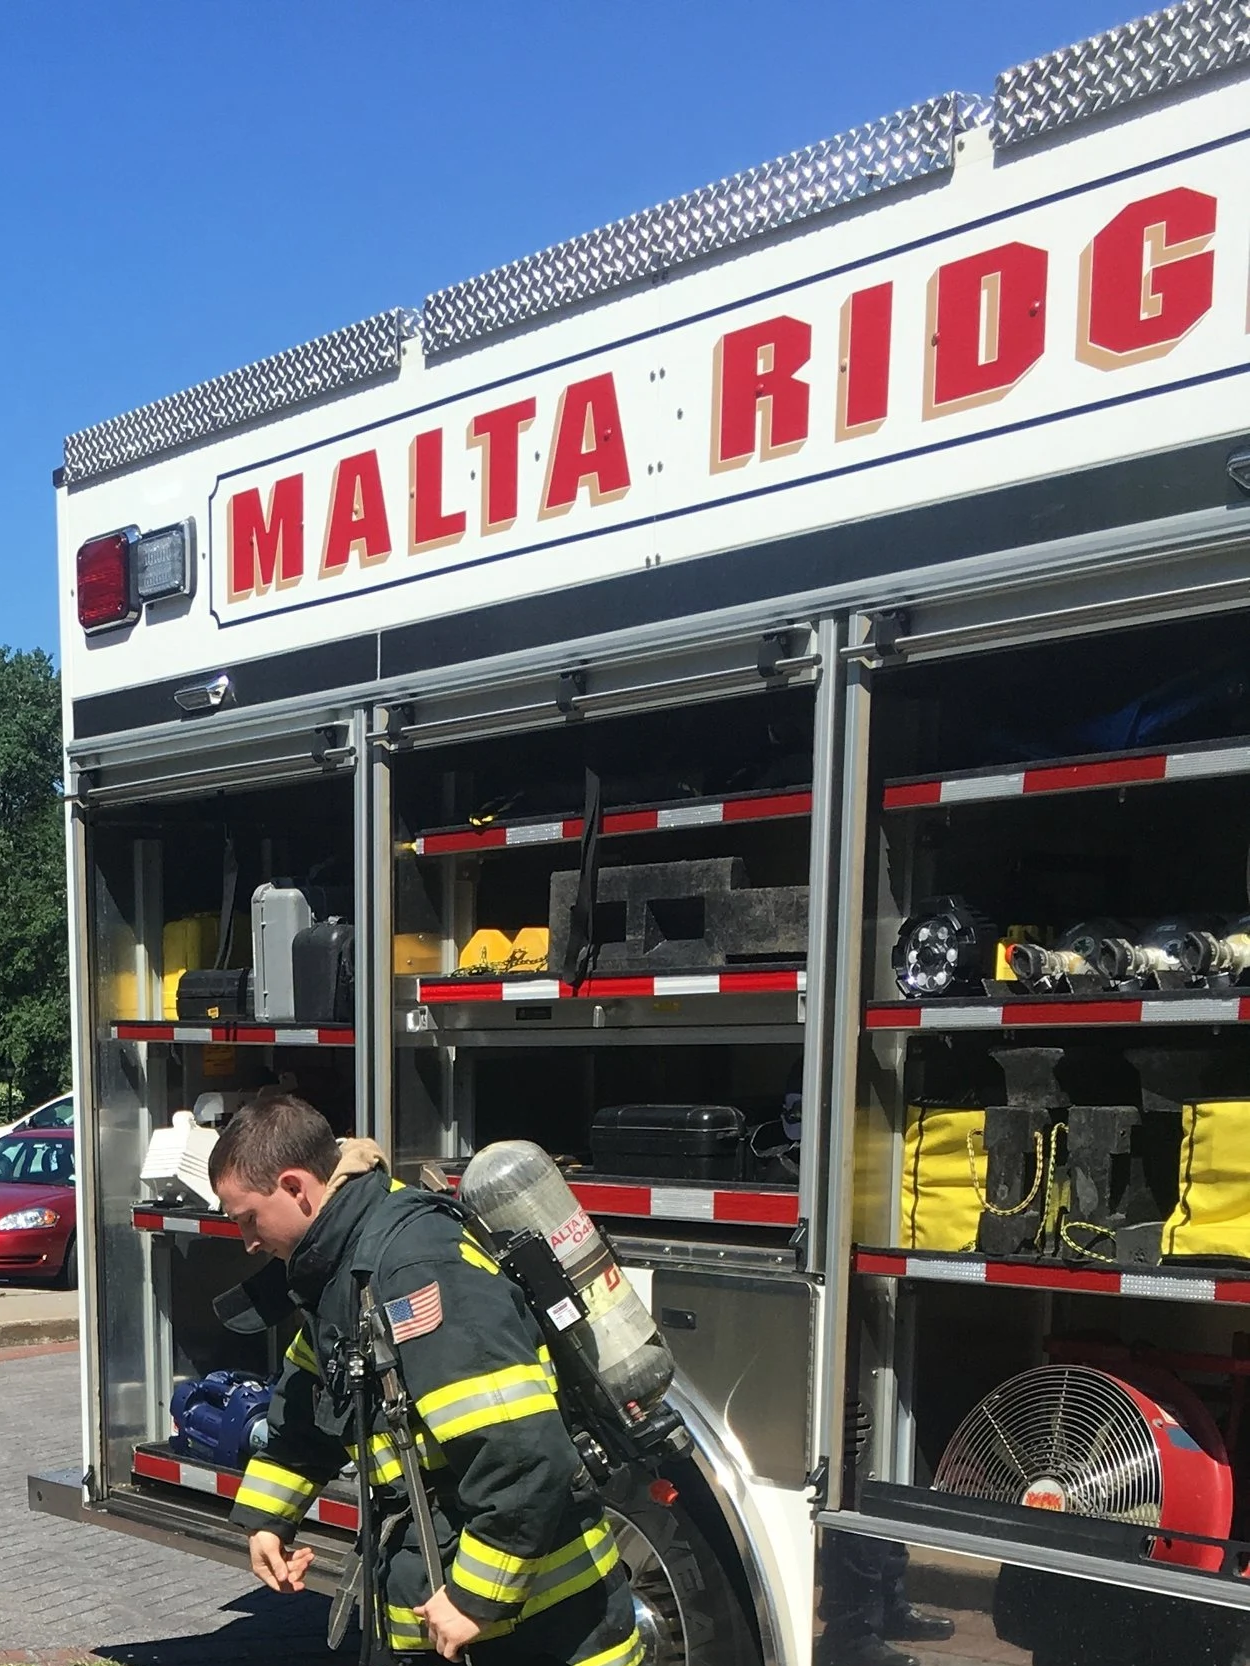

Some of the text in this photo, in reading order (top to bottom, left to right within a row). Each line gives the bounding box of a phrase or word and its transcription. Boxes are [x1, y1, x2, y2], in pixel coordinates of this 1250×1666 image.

[227, 186, 1250, 604] MALTA RIDG
[550, 1219, 581, 1250] ALTA
